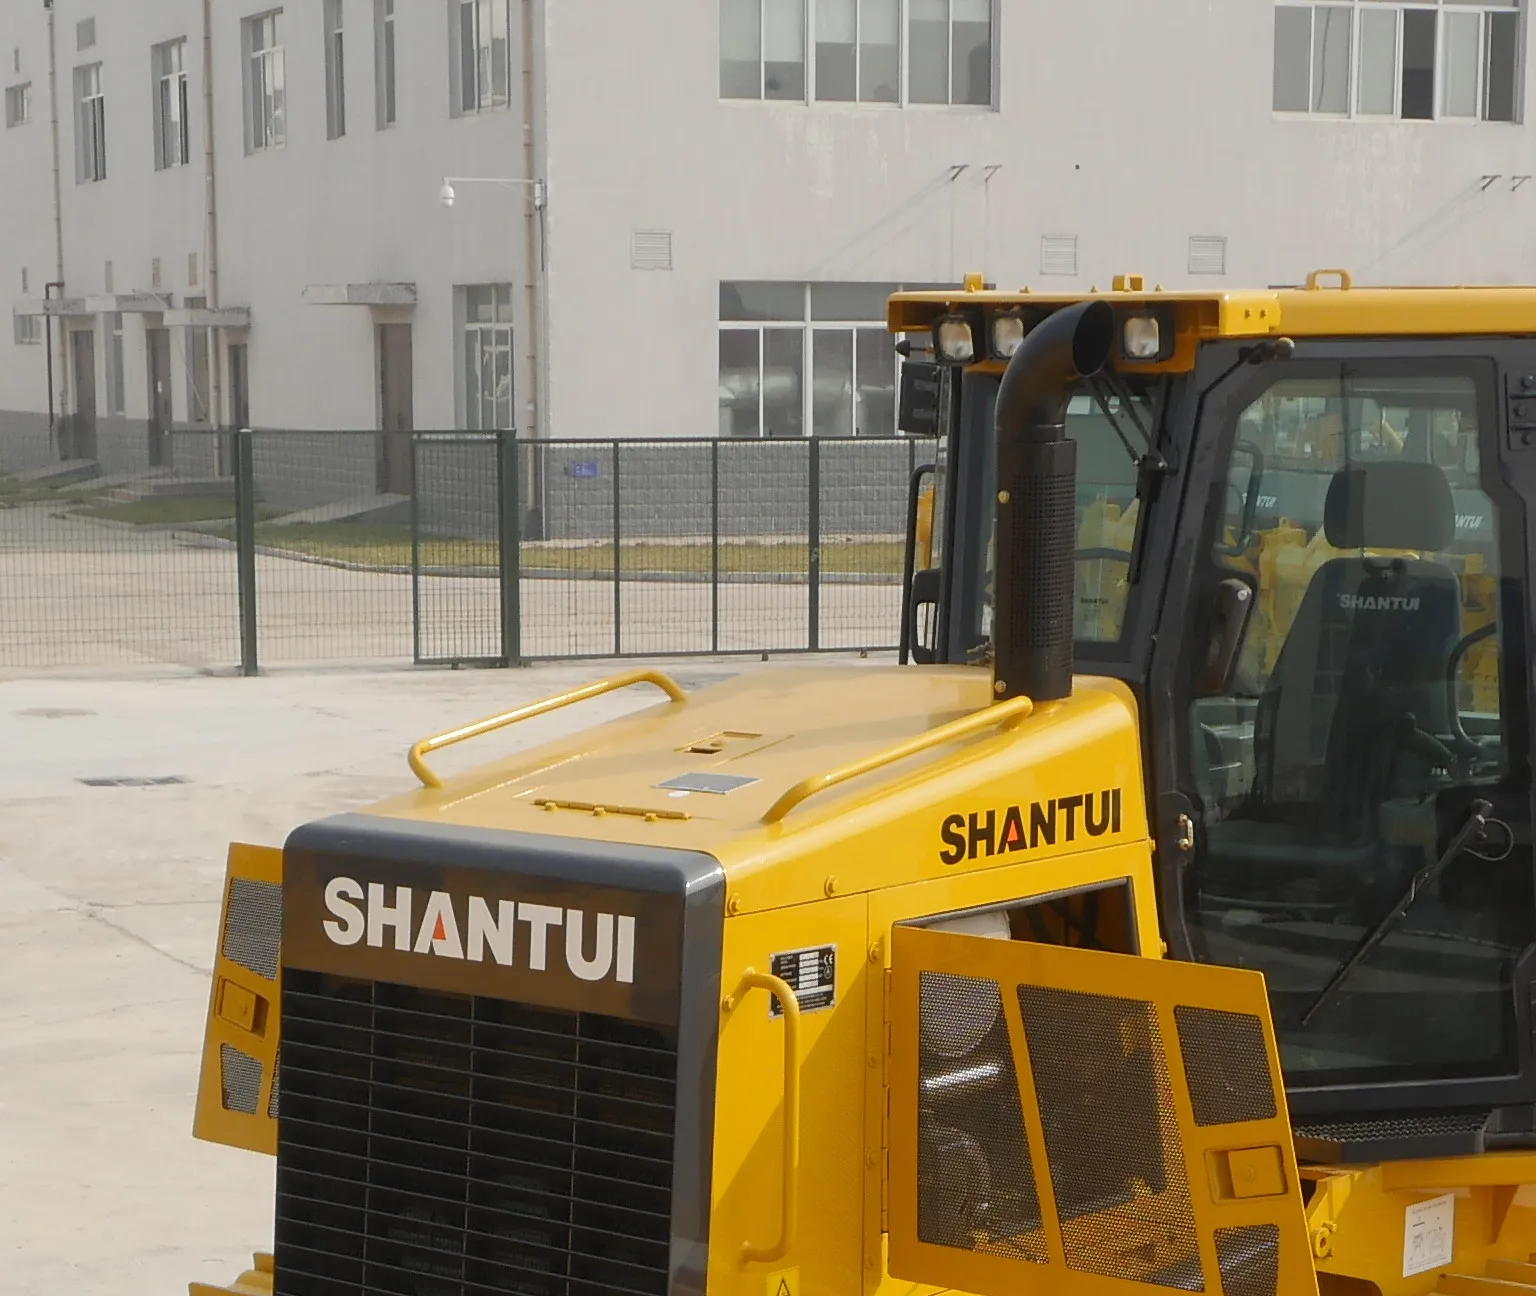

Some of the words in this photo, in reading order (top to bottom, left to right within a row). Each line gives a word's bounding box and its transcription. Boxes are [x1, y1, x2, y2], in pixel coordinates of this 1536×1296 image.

[1339, 593, 1421, 611] SHANTUI
[939, 788, 1121, 865] SHANTUI
[322, 876, 636, 983] SHANTUI
